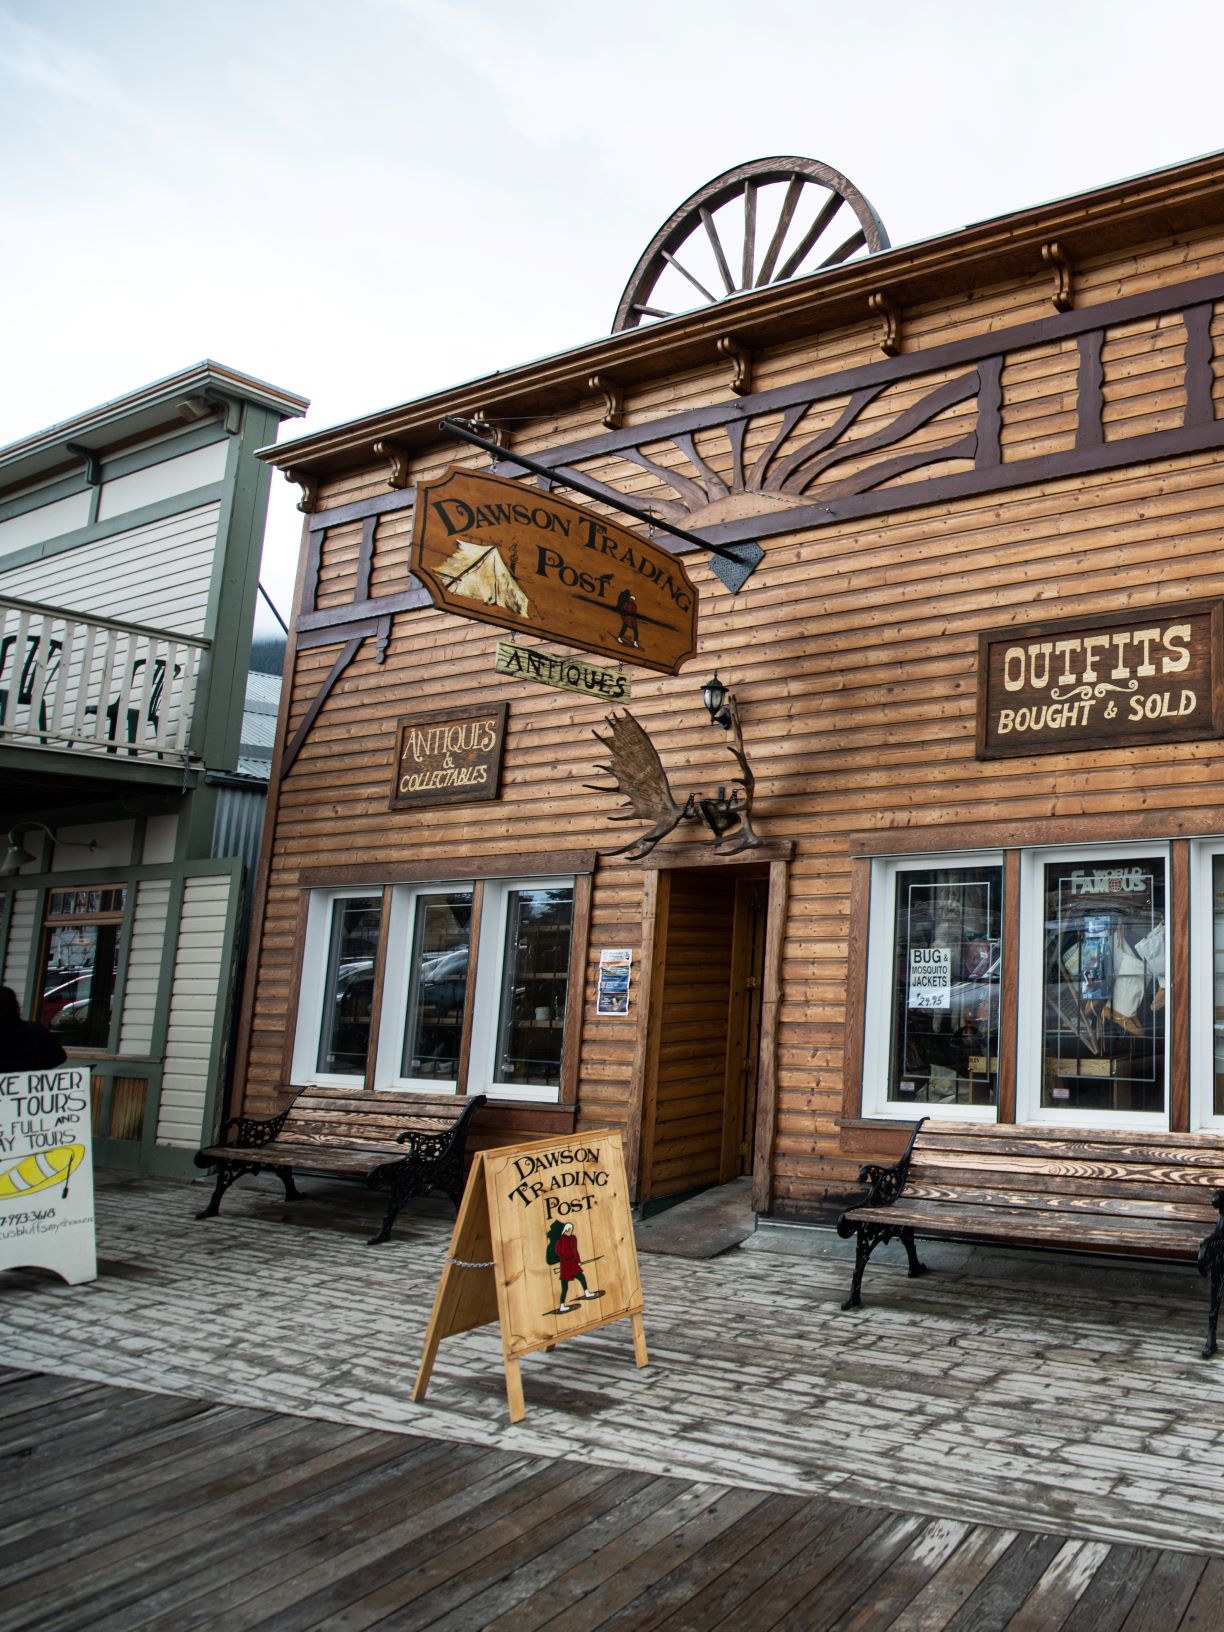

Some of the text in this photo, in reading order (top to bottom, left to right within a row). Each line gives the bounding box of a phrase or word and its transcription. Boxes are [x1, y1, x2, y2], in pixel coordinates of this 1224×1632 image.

[432, 498, 692, 613] DAWSON TRADING
[535, 544, 614, 597] POST
[1004, 624, 1192, 692] OUTFITS
[505, 650, 628, 699] ANTIQUES
[997, 690, 1197, 734] BOUGHT & SOLD
[402, 720, 497, 762] ANTIQUES
[442, 752, 455, 768] &
[400, 765, 488, 793] COLLECTABLES
[912, 965, 948, 974] MOSQUITO
[913, 949, 942, 963] BUG
[912, 976, 948, 987] JACKETS
[28, 1071, 83, 1094] RIVER
[10, 1090, 87, 1117] TOURS
[11, 1119, 51, 1136] FULL
[54, 1113, 81, 1128] AND
[24, 1129, 77, 1149] TOURS
[513, 1148, 600, 1182] DAWSON
[508, 1170, 610, 1208] TRADING
[545, 1195, 596, 1221] POST
